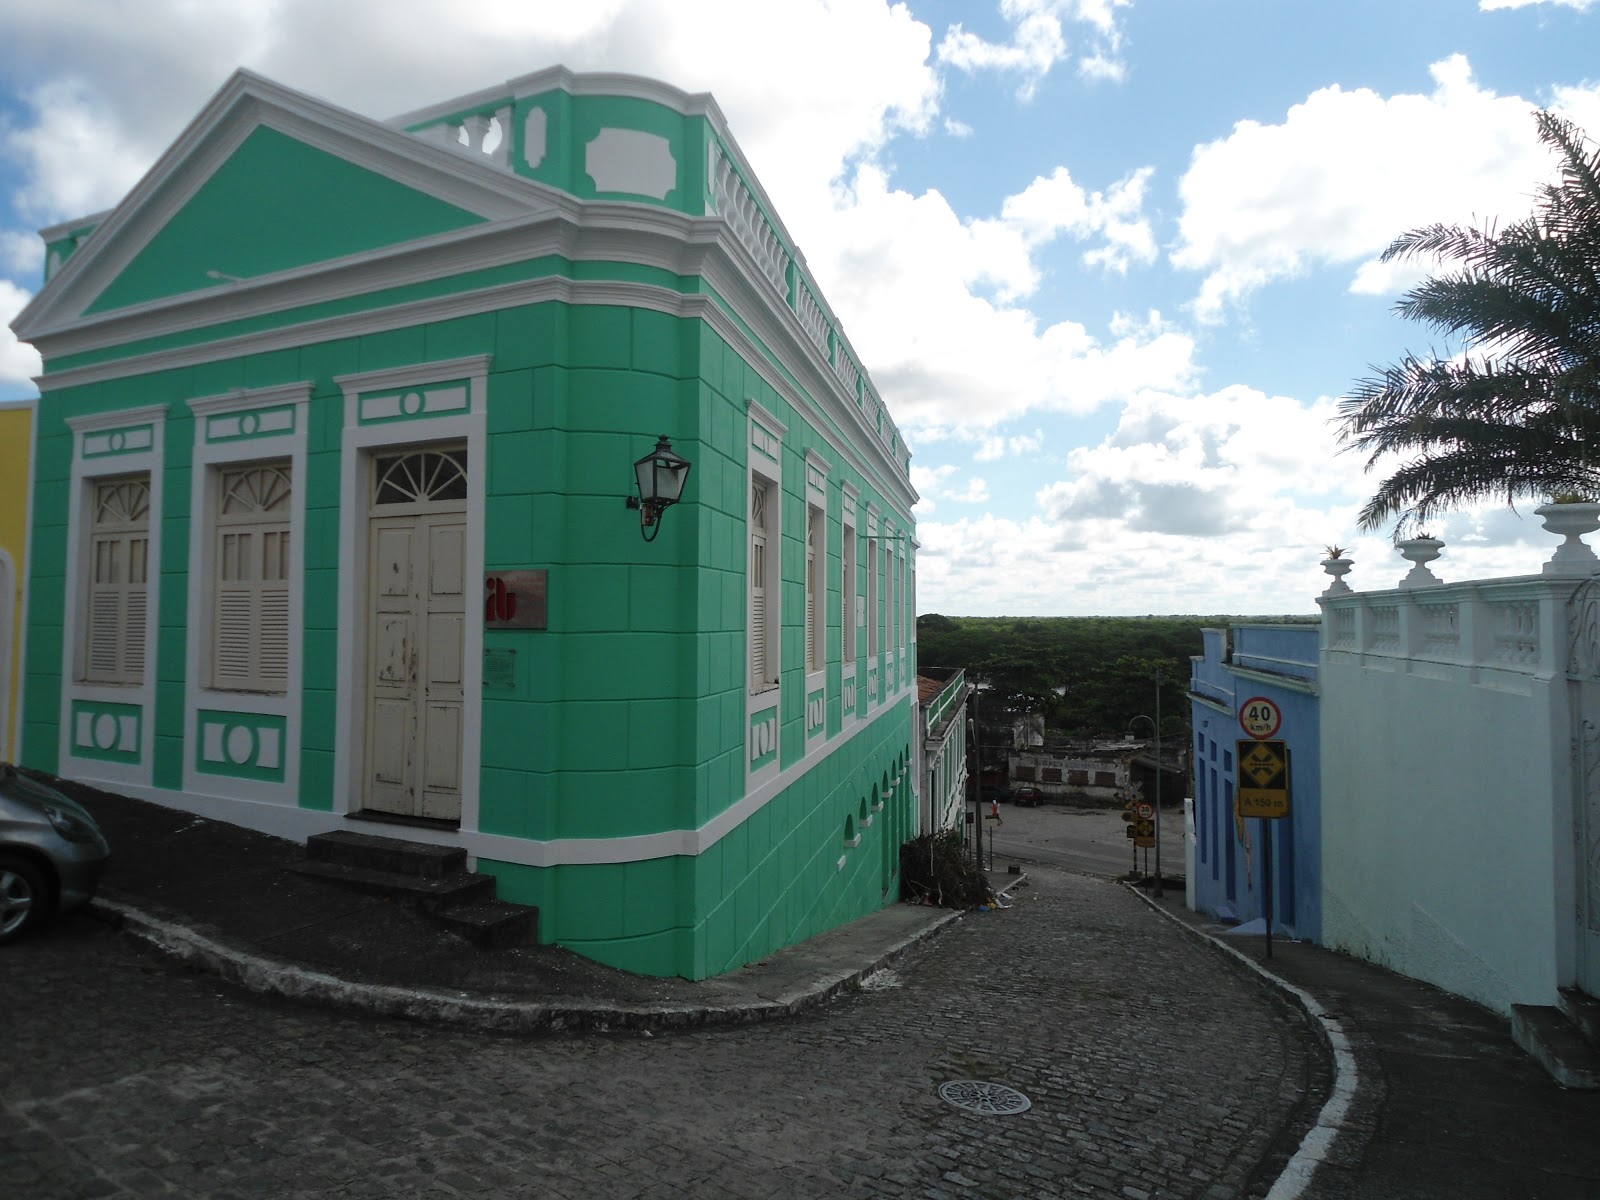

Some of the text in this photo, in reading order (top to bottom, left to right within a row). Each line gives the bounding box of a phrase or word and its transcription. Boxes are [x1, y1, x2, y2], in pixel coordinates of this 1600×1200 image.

[1249, 706, 1270, 721] 40
[1250, 723, 1271, 731] km/h
[1244, 797, 1284, 808] A 150 m
